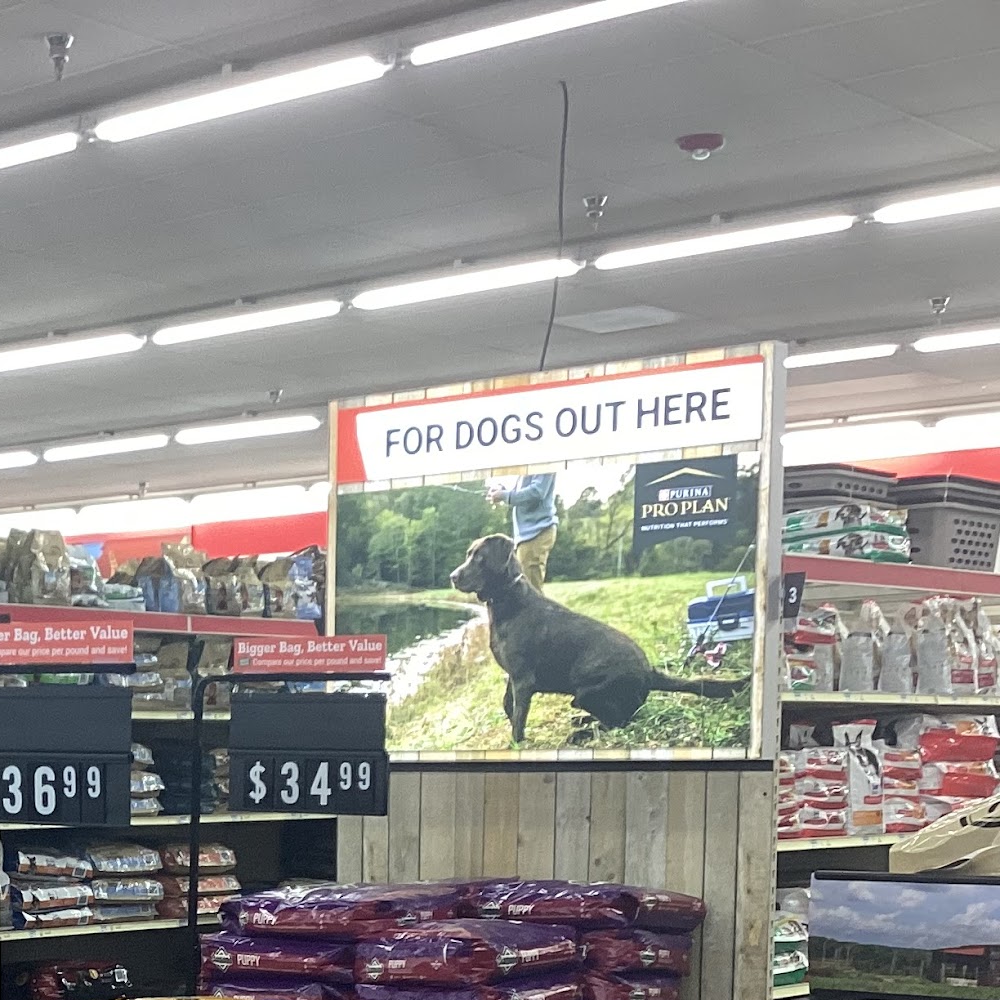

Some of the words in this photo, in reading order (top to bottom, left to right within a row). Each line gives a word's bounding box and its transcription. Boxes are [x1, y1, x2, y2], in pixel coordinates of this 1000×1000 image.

[386, 424, 443, 457] FOR
[455, 411, 543, 450] DOGS
[555, 400, 626, 438] OUT
[637, 387, 731, 428] HERE
[670, 487, 709, 499] PURINA
[676, 521, 692, 529] THAT
[788, 587, 797, 604] 3
[13, 628, 41, 645] Bag,
[44, 627, 87, 641] Better
[89, 625, 129, 640] Value
[18, 648, 30, 656] our
[31, 646, 50, 658] price
[51, 648, 64, 657] per
[65, 645, 89, 656] pound
[91, 645, 106, 654] and
[237, 642, 277, 657] Bigger
[279, 641, 304, 655] Bag,
[307, 640, 346, 653] Better
[349, 639, 382, 651] Value
[252, 658, 282, 667] Compare
[295, 658, 313, 667] price
[326, 657, 349, 666] pound
[349, 656, 363, 665] and
[508, 904, 535, 915] PUPPY
[253, 911, 278, 926] PUPPY
[237, 953, 261, 967] PUPPY
[388, 959, 407, 969] PUPPY
